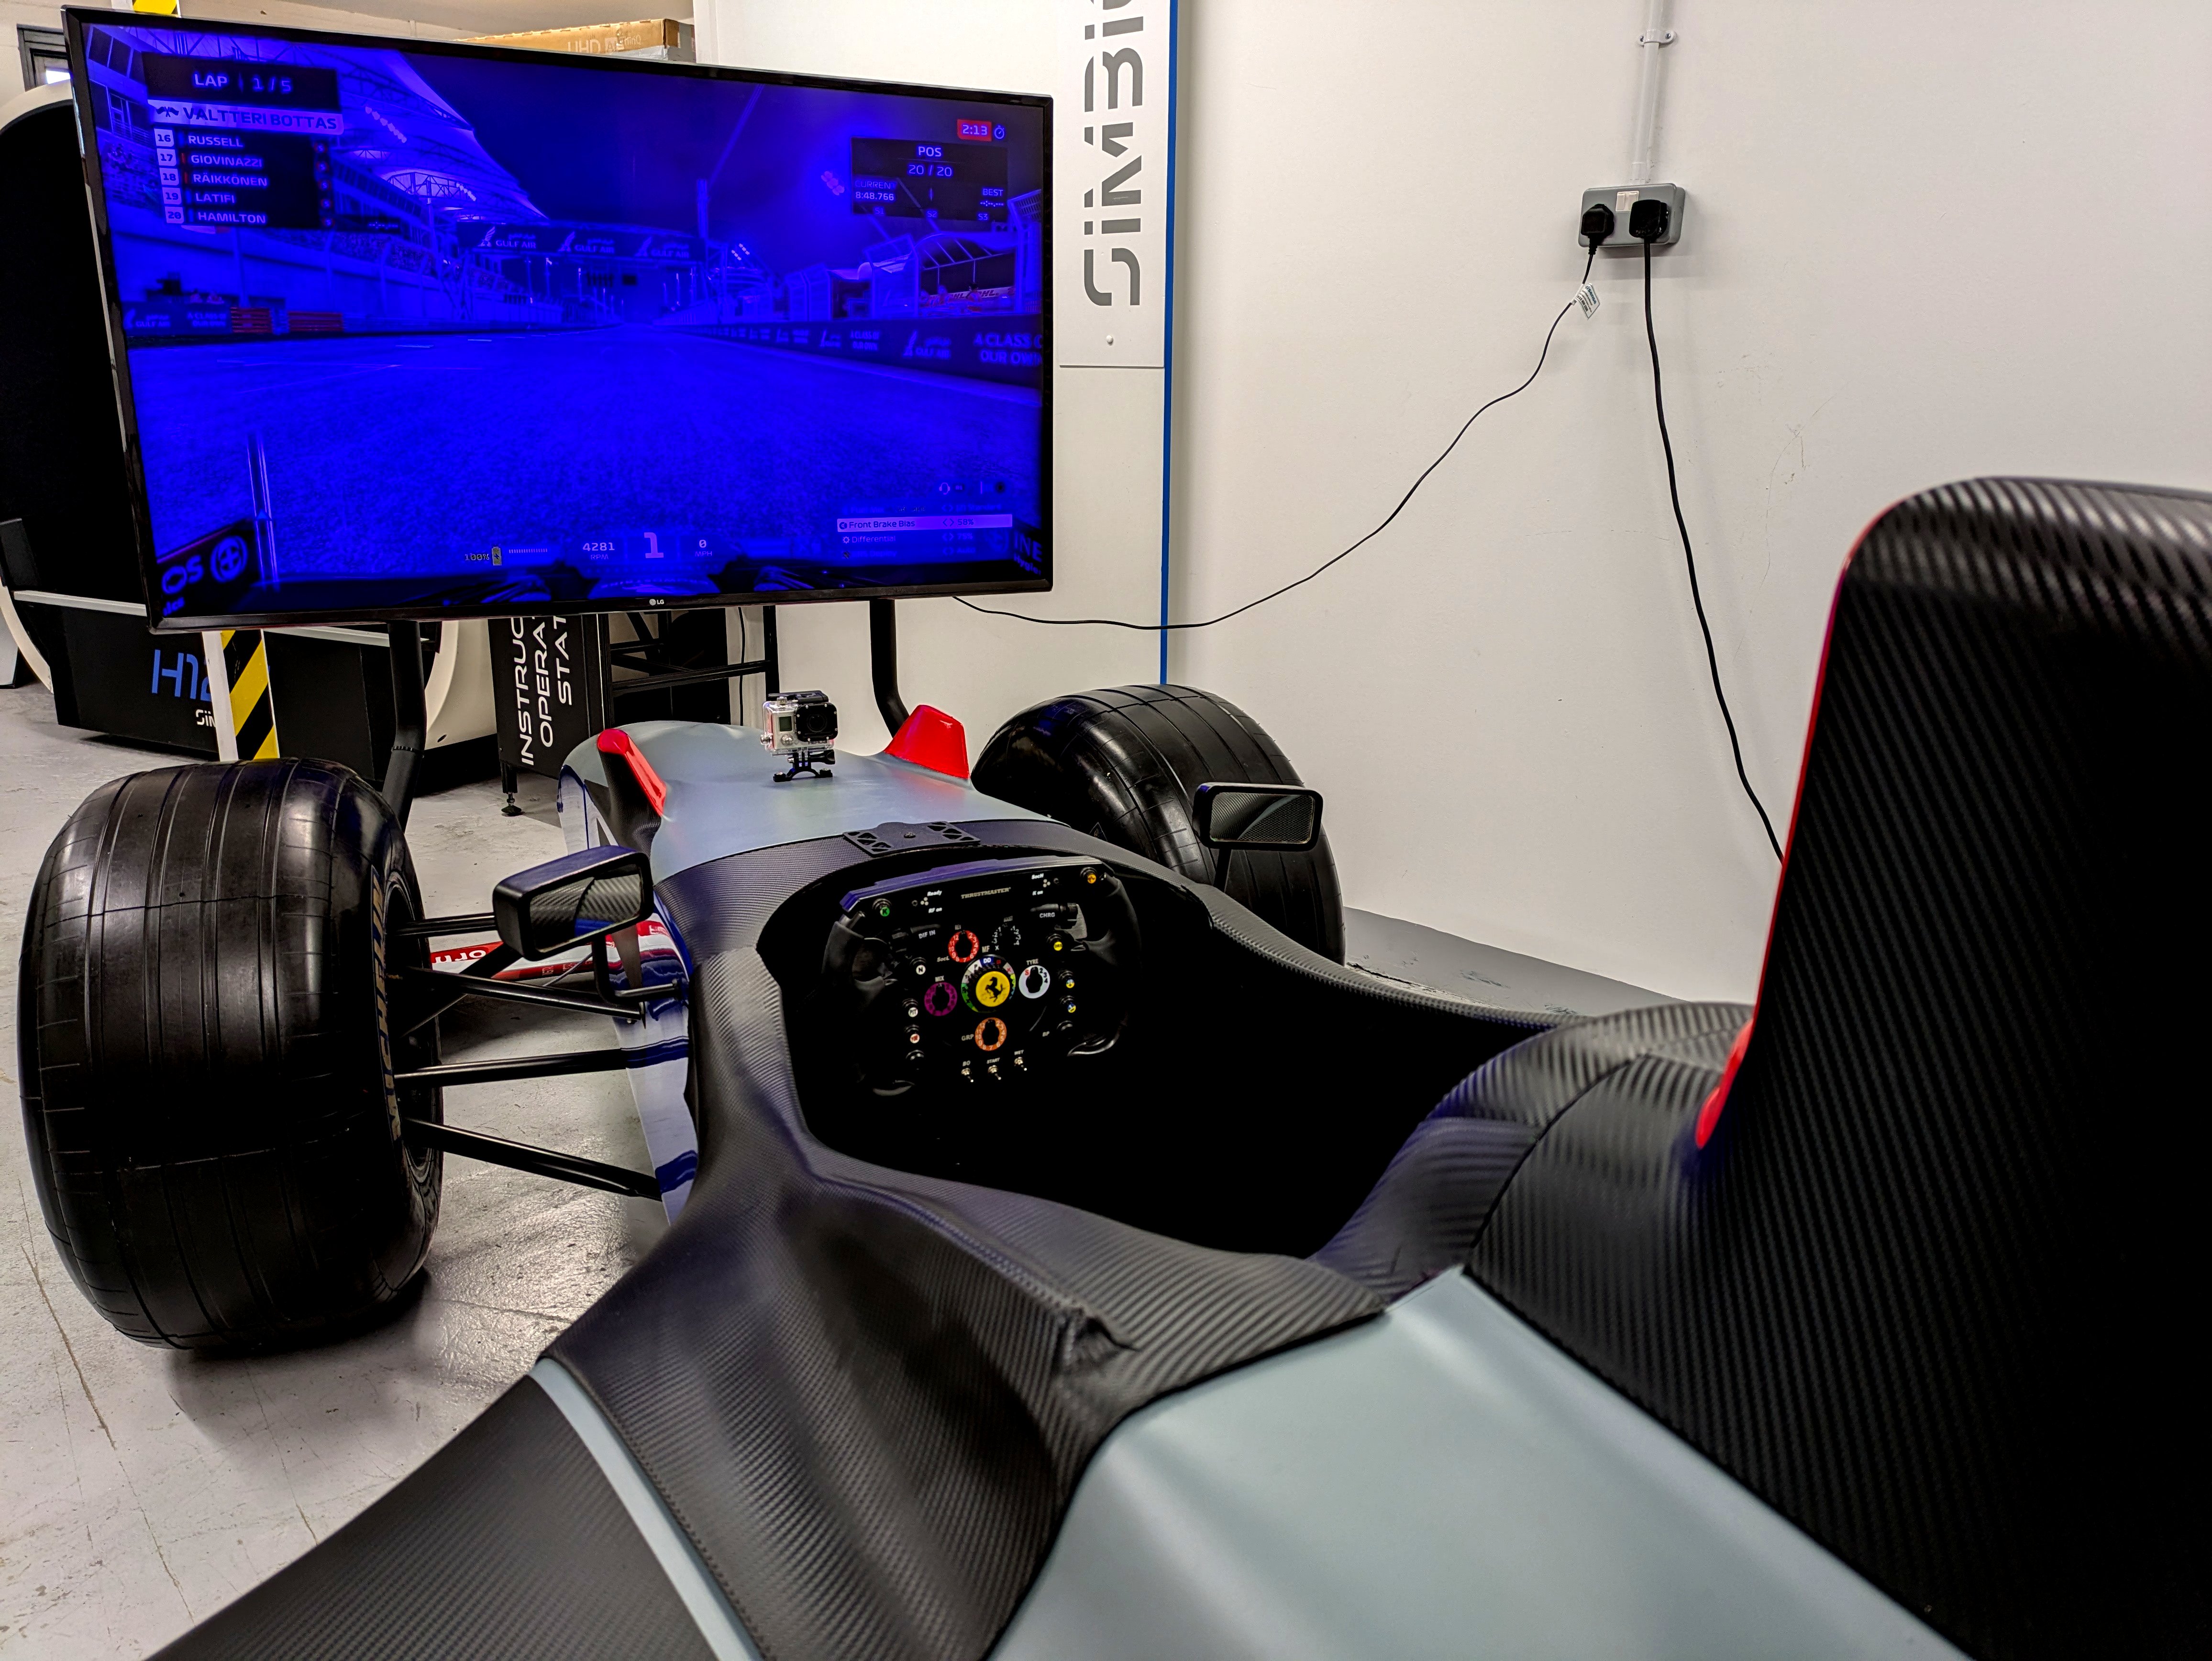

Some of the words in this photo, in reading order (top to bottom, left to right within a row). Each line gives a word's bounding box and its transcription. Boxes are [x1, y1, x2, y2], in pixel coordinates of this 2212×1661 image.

[194, 74, 228, 87] LAP
[183, 107, 267, 125] VALTTERI
[270, 114, 337, 130] BOTTAS
[962, 124, 988, 136] 2:13
[157, 133, 171, 143] 16
[188, 135, 244, 147] RUSSELL
[918, 146, 942, 157] POS
[160, 153, 174, 162] 17
[191, 155, 263, 167] GIOVINAZZI
[163, 173, 177, 181] 18
[166, 192, 179, 200] 19
[196, 193, 235, 203] LATIFI
[982, 188, 1004, 197] BEST
[167, 211, 182, 220] 20
[198, 212, 266, 224] HAMILTON
[496, 240, 520, 248] GULF
[575, 244, 598, 252] GULF
[600, 246, 615, 254] AIR
[985, 333, 1031, 348] CLASS
[980, 350, 1007, 364] OUR
[583, 542, 615, 552] 4281
[643, 532, 664, 559] 1
[698, 539, 707, 548] 0
[531, 616, 553, 748] OPERA
[511, 617, 534, 766] INSTRUC
[961, 887, 1009, 899] THRUSTMASTER
